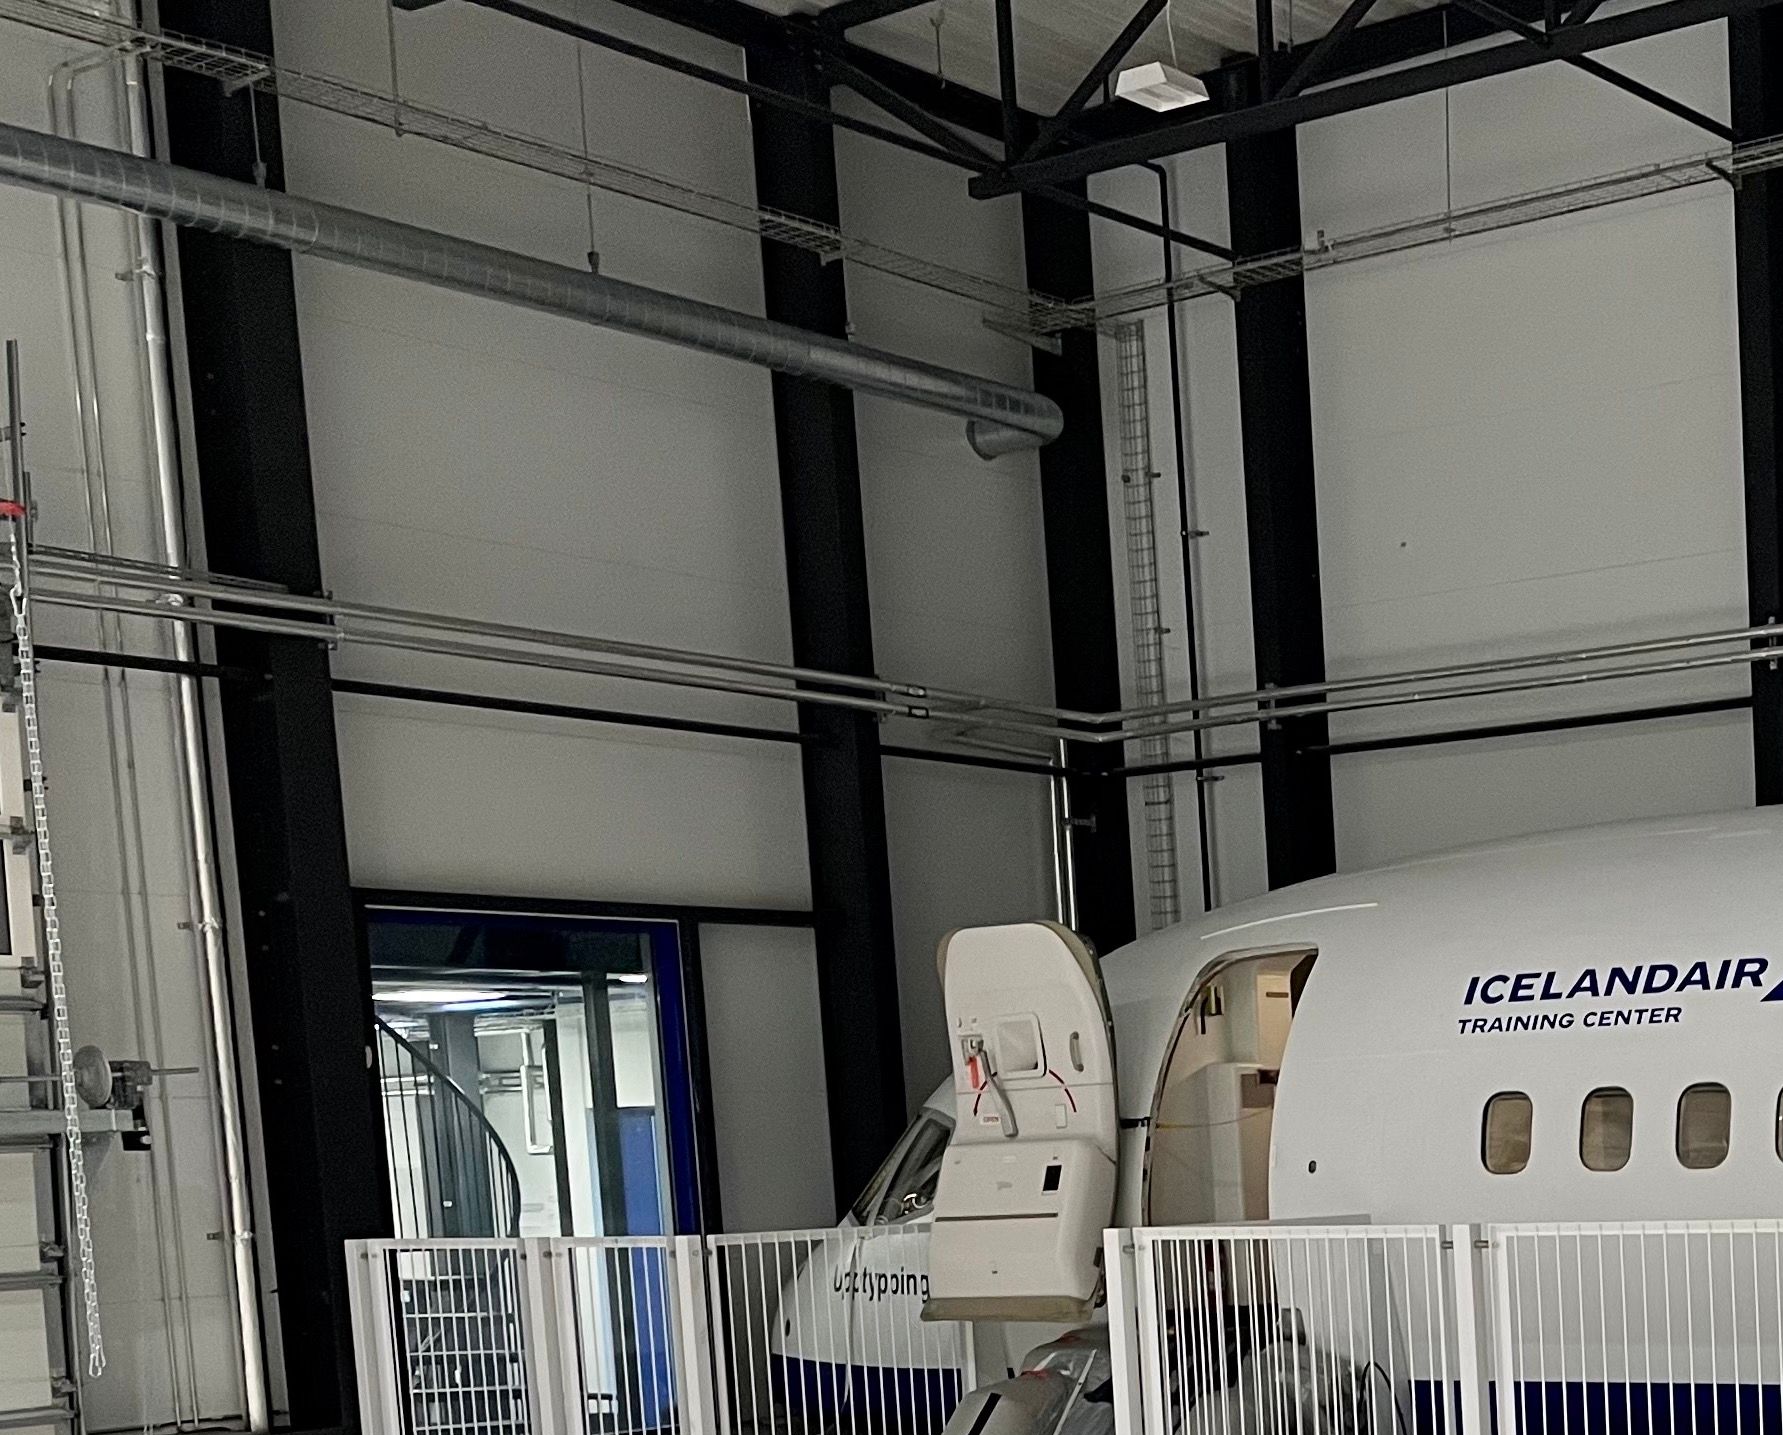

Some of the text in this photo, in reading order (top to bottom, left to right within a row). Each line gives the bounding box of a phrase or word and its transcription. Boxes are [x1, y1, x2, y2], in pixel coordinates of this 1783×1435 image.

[1463, 957, 1769, 1005] ICELANDAIR
[1458, 1006, 1683, 1034] TRAINING CENTER
